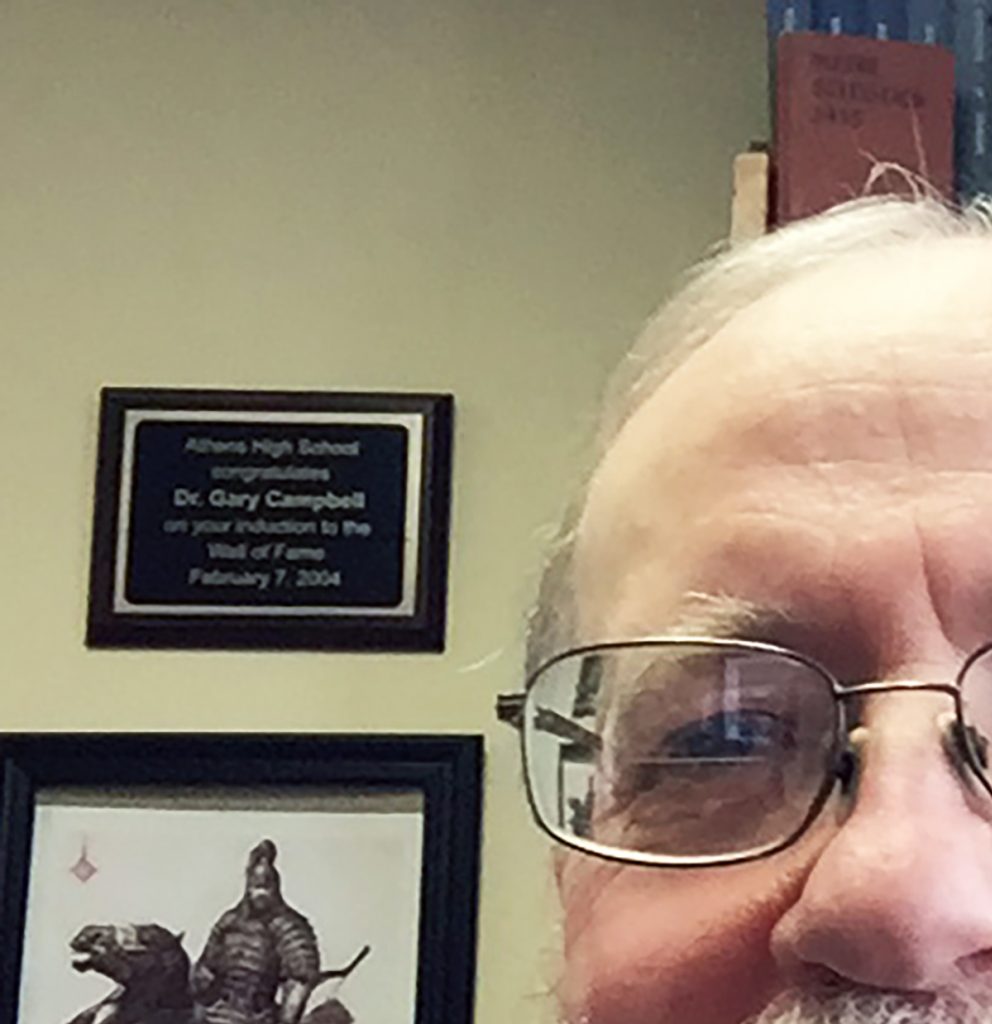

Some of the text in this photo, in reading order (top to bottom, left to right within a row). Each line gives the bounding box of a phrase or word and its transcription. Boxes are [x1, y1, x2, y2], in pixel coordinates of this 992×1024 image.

[251, 440, 293, 458] High
[298, 438, 360, 456] School
[173, 488, 366, 512] Dr. Gary Campbell
[190, 520, 233, 537] your
[234, 518, 317, 535] induction
[320, 519, 339, 535] to
[341, 519, 373, 537] the
[250, 543, 273, 560] of
[272, 543, 326, 561] Fame
[187, 567, 271, 590] February
